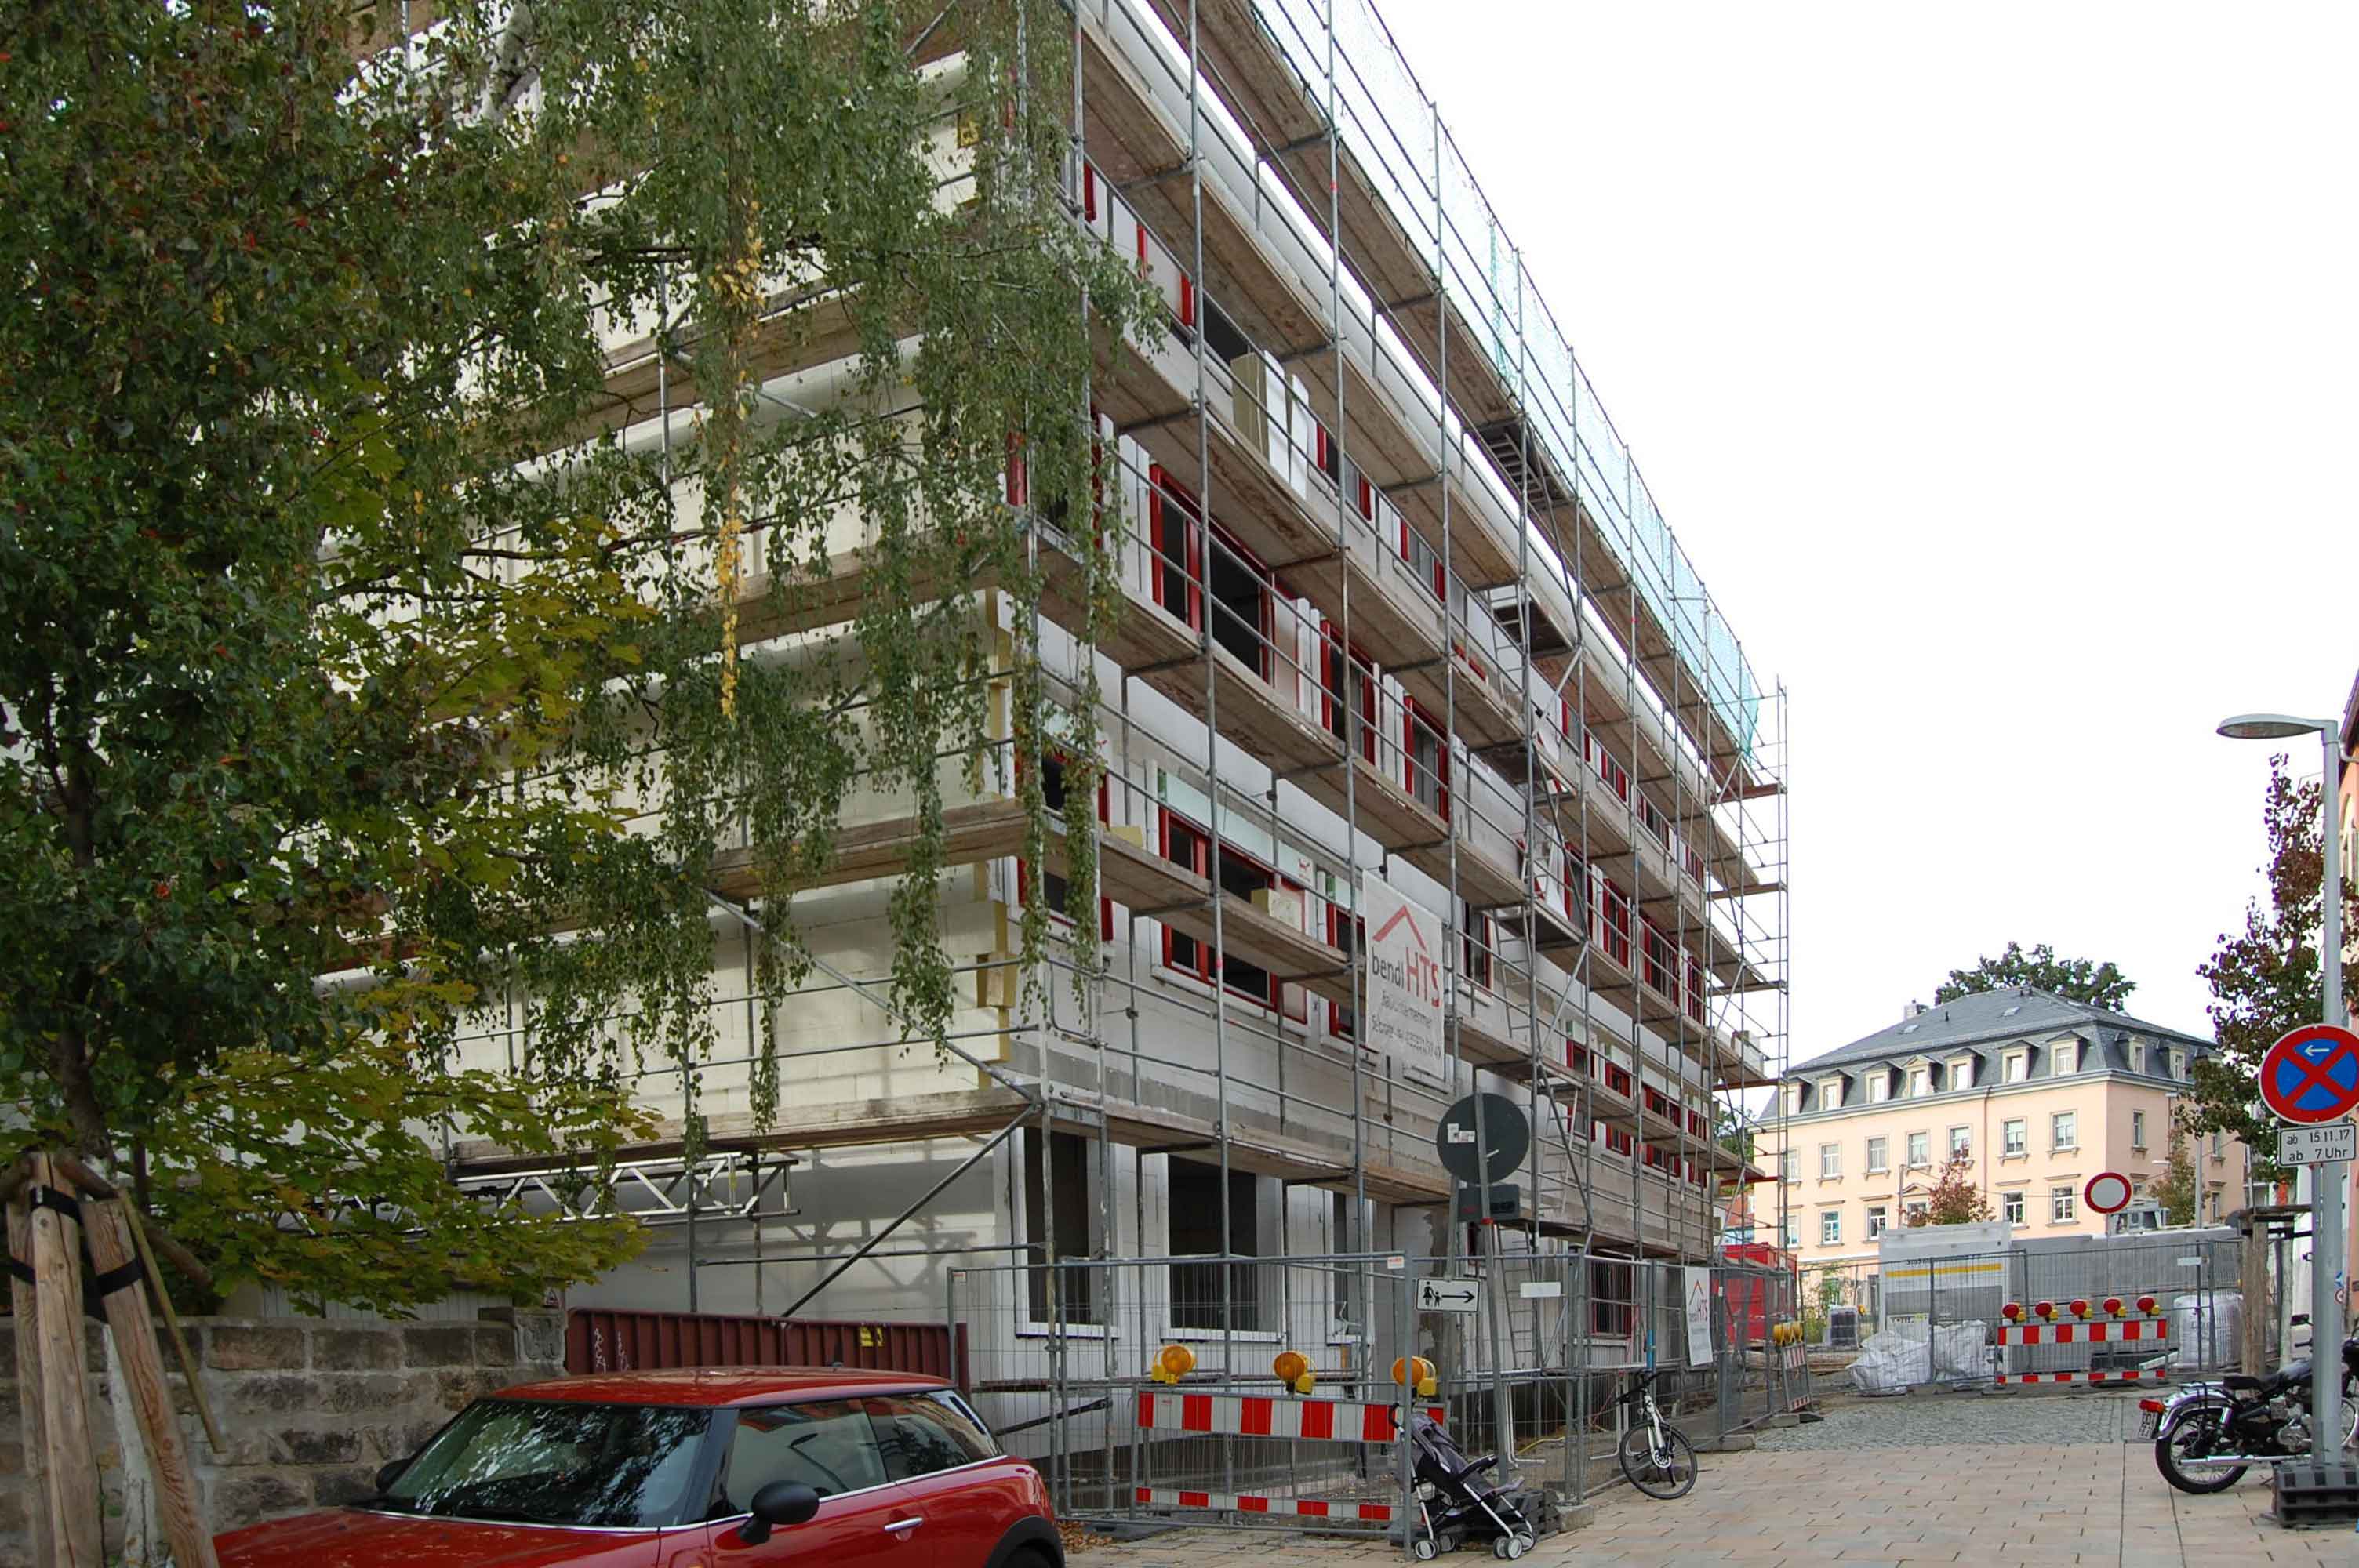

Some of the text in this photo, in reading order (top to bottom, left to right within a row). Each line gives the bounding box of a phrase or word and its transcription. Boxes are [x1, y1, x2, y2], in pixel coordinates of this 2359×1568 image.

[1372, 946, 1440, 1007] bendl HTS
[2287, 1129, 2350, 1145] ab 15.11.17
[2288, 1147, 2348, 1162] ab 7 Uhr
